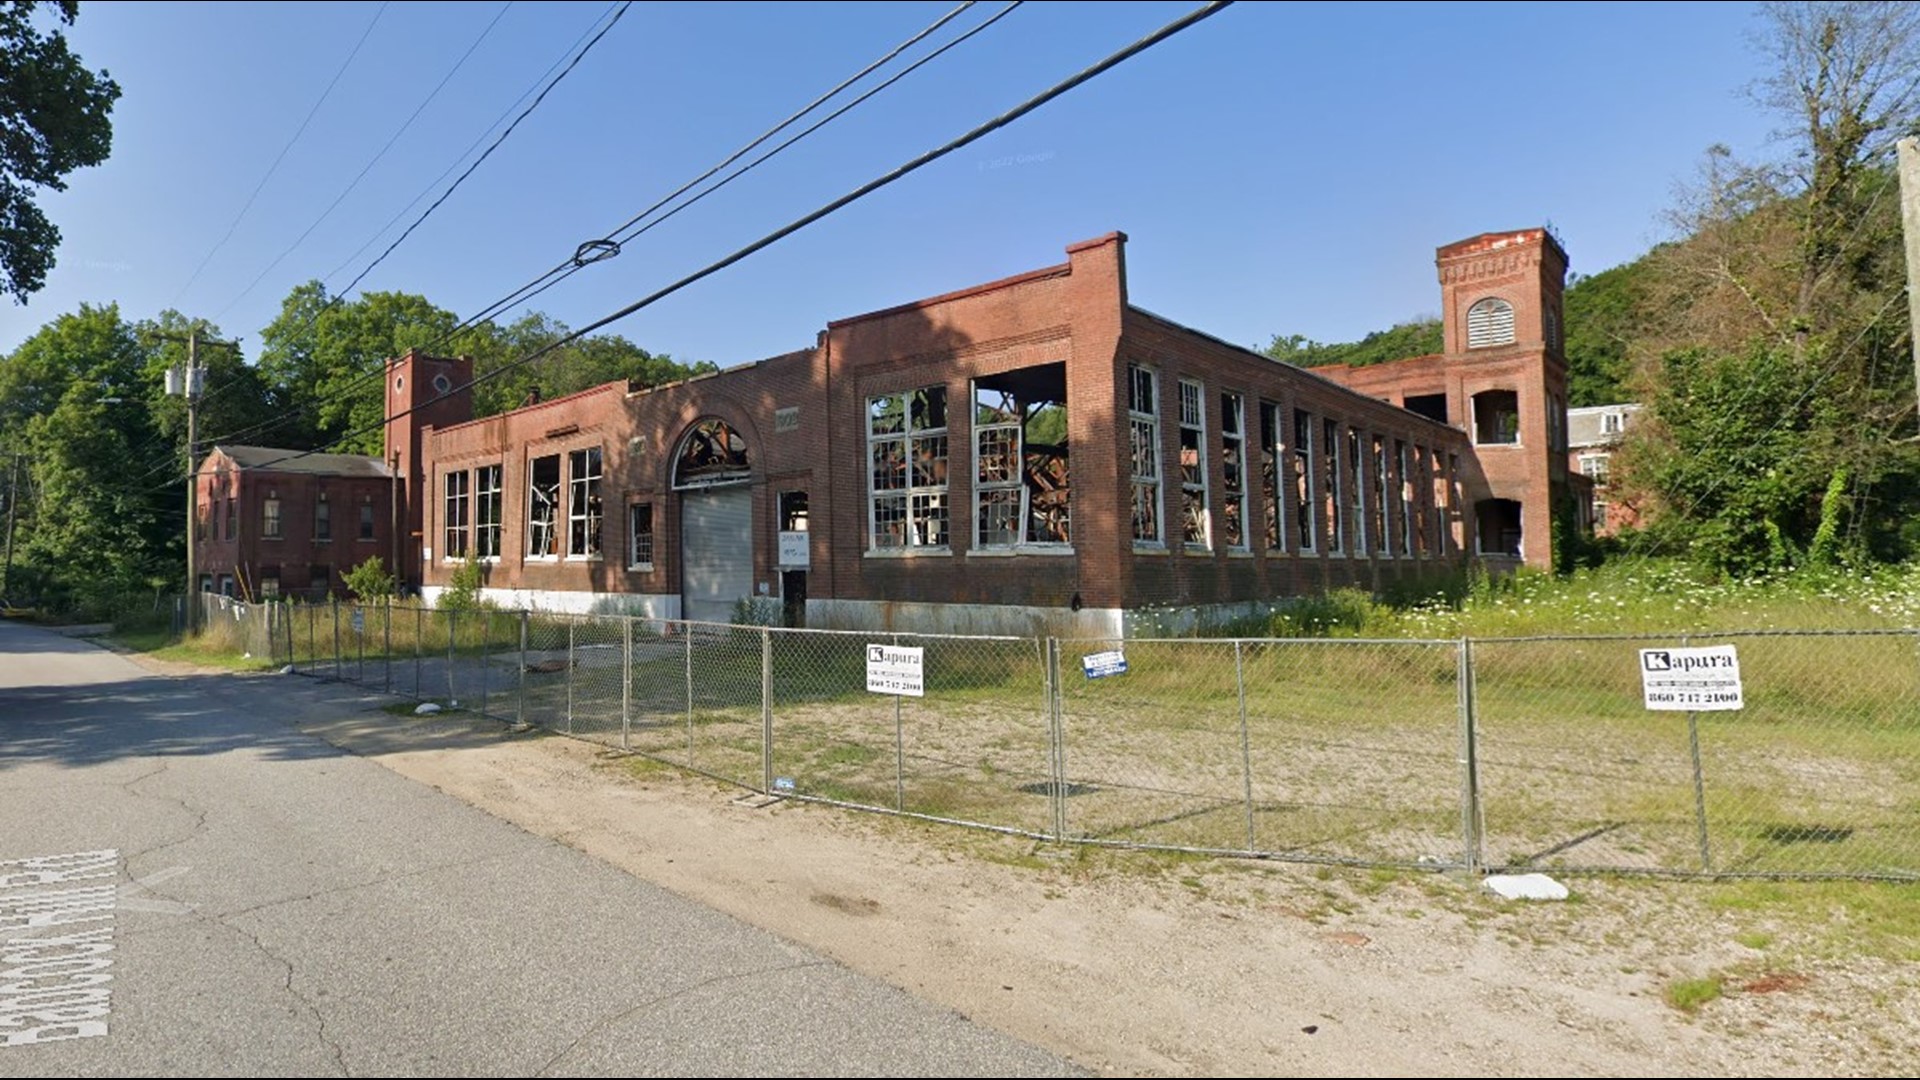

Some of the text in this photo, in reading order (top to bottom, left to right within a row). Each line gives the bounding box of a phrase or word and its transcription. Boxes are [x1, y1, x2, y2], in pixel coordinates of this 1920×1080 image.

[868, 646, 920, 665] Kapura
[1644, 651, 1734, 672] Kapura
[1648, 692, 1675, 703] 860
